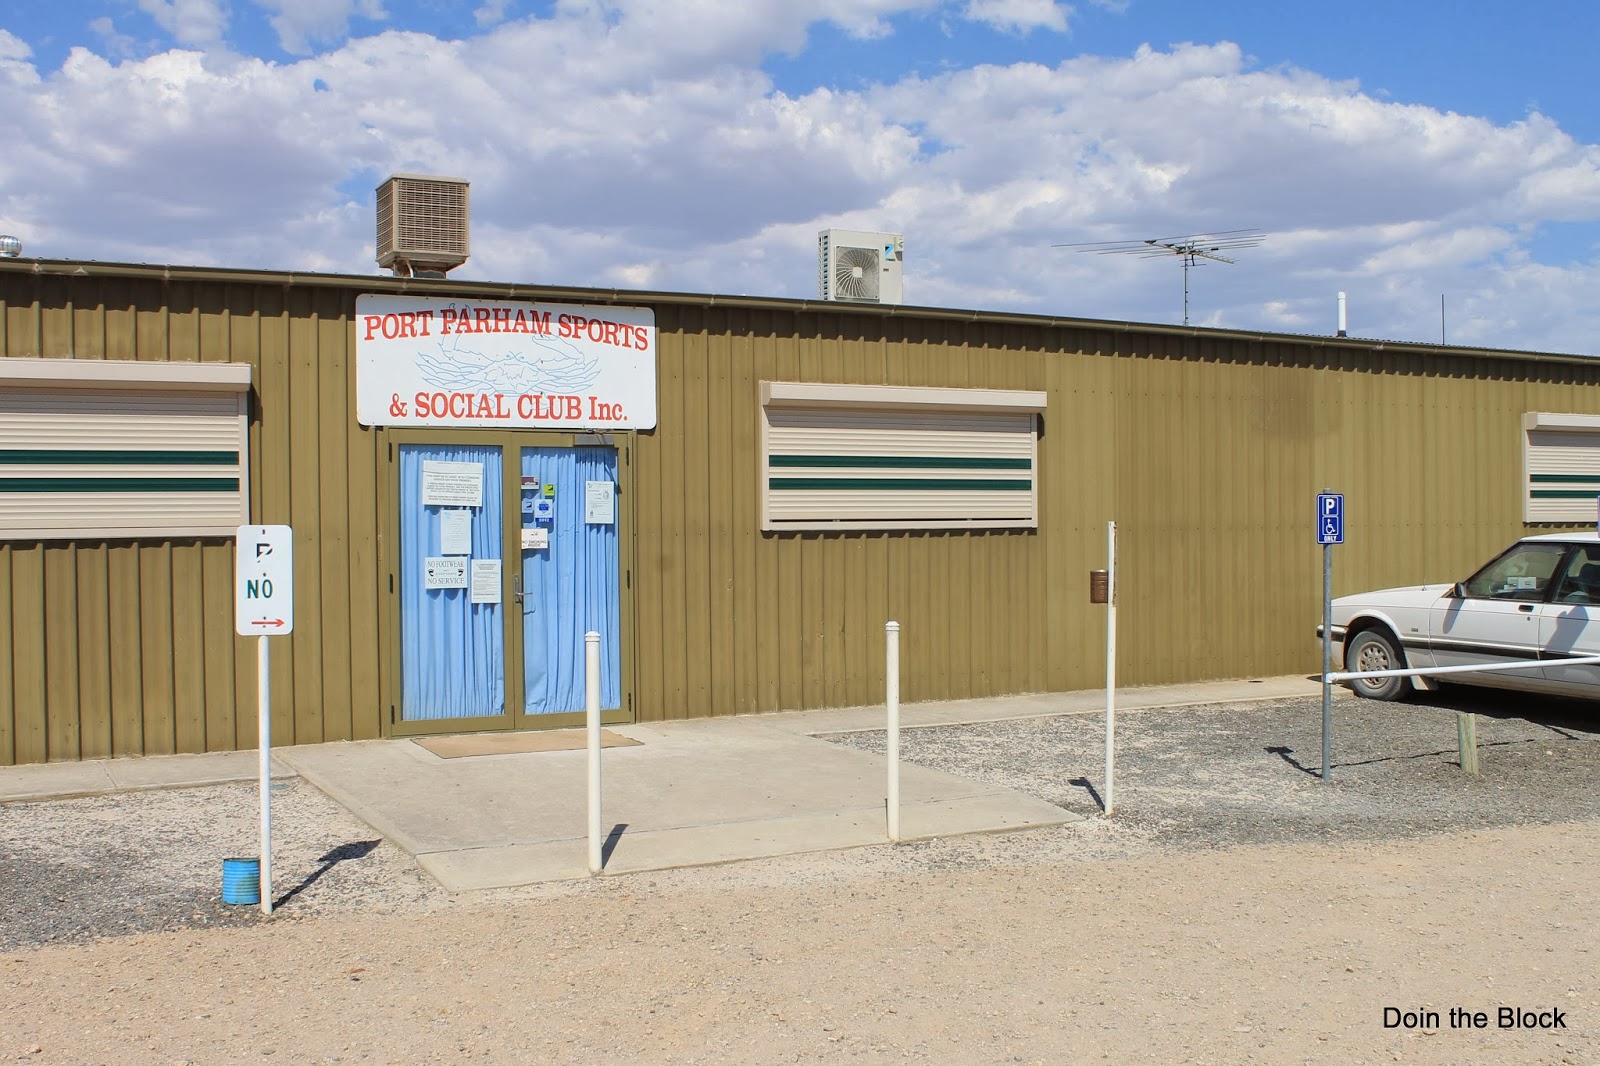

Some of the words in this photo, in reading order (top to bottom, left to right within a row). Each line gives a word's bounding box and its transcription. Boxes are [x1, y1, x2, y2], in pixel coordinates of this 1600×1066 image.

[364, 310, 433, 341] PORT
[441, 308, 552, 334] PARHAM
[558, 314, 648, 351] SPORTS
[389, 393, 408, 418] &
[415, 392, 511, 418] SOCIAL
[517, 394, 582, 420] CLUB
[589, 396, 628, 421] Inc.
[1325, 498, 1335, 515] P
[427, 560, 436, 568] NO
[436, 560, 464, 568] FOOTWEAR
[247, 579, 273, 599] NO
[427, 577, 438, 585] NO
[438, 577, 465, 585] SERVICE
